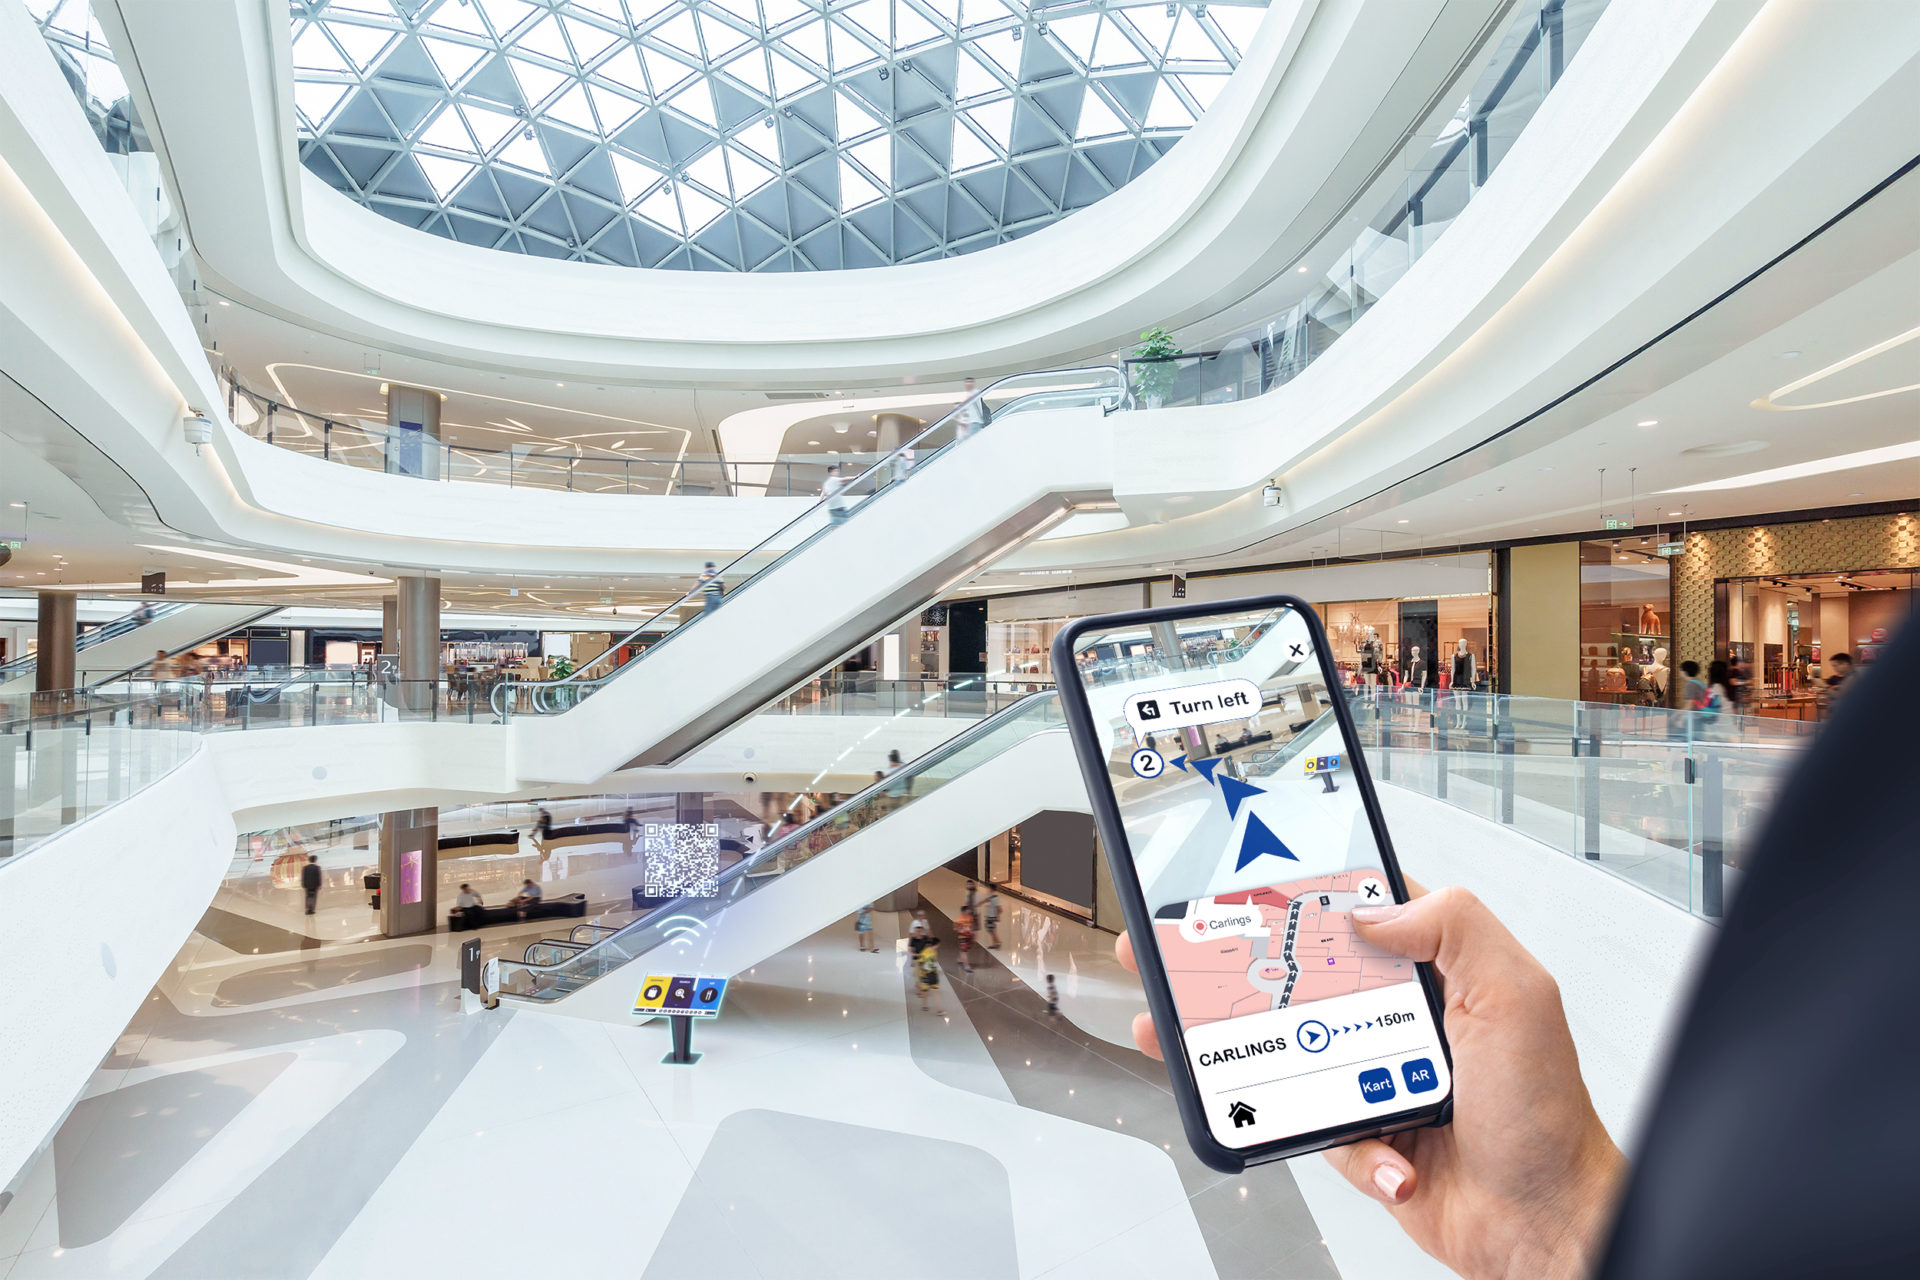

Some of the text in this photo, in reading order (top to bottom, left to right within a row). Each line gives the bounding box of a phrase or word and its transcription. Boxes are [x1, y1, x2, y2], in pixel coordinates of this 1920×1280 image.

[1169, 692, 1250, 715] Turn left
[1140, 755, 1155, 771] 2
[1209, 915, 1252, 930] Carlings
[1375, 1010, 1415, 1028] 150m
[1199, 1037, 1287, 1067] CARLINGS
[1411, 1067, 1430, 1082] AR
[1362, 1077, 1392, 1093] Kart
